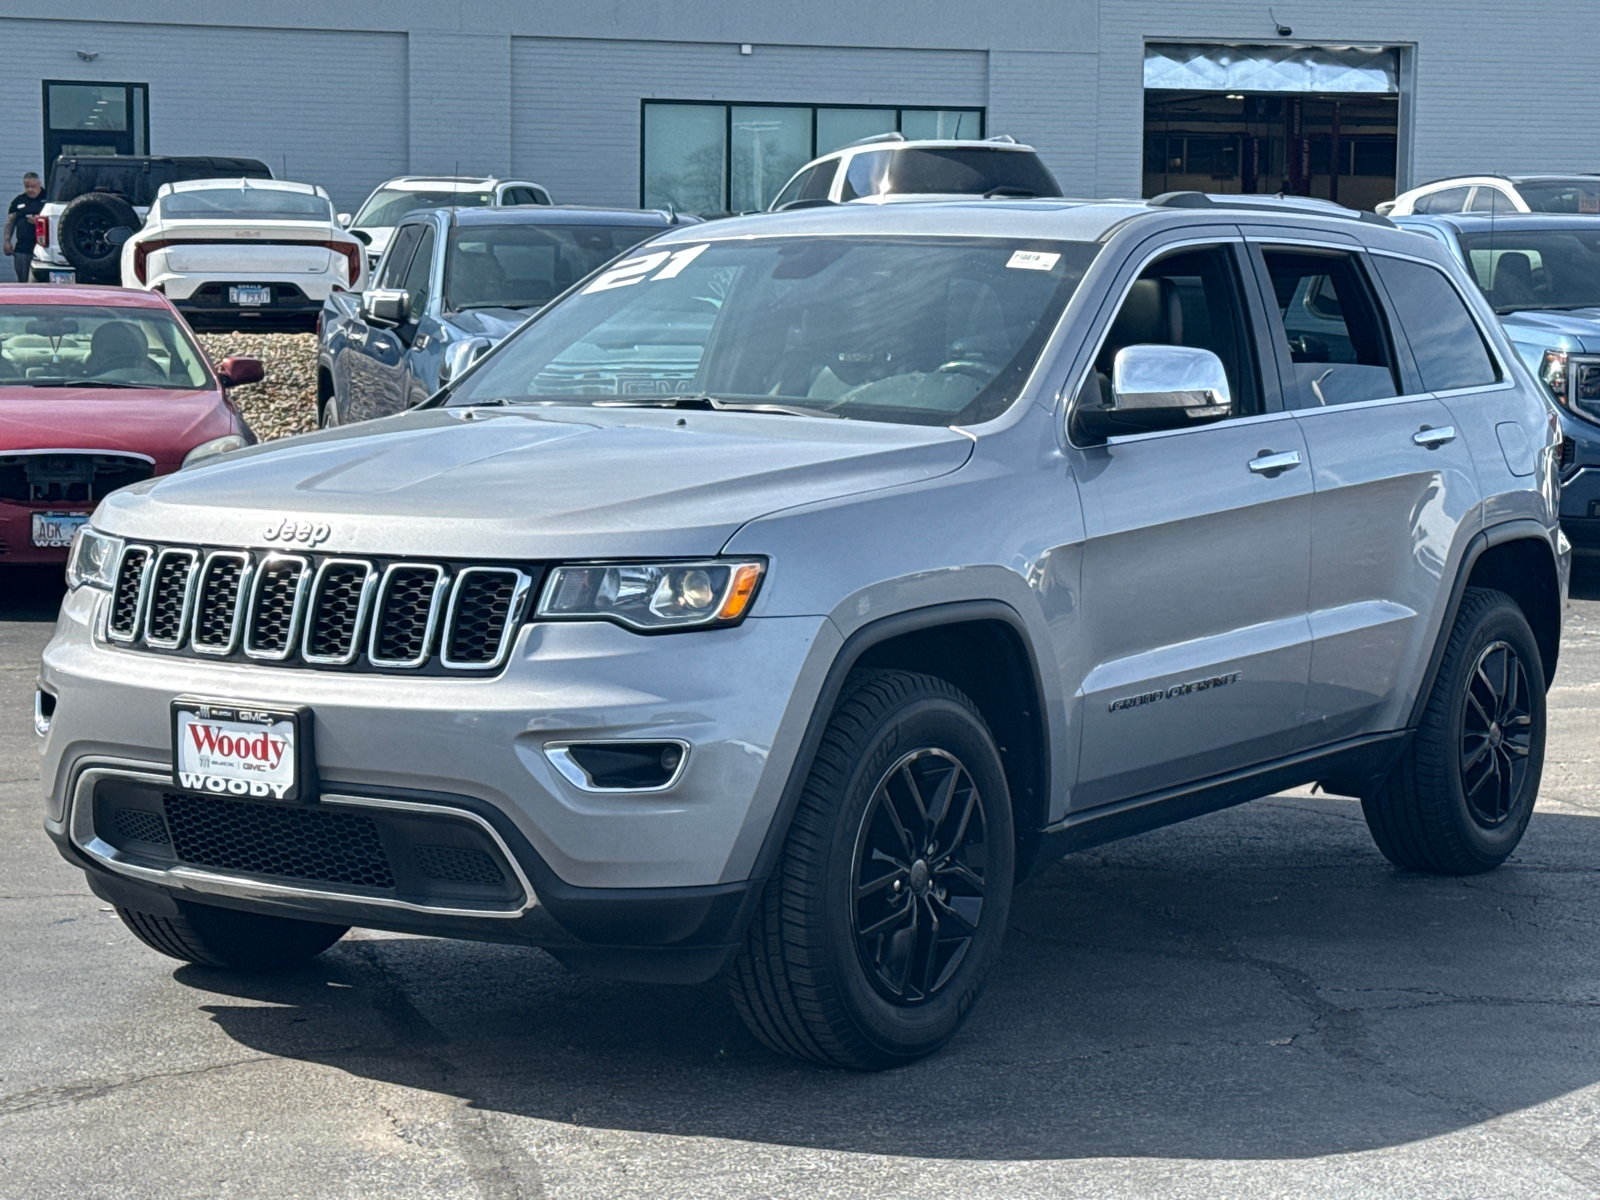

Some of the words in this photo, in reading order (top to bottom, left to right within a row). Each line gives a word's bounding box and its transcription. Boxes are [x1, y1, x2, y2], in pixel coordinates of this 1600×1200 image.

[580, 243, 711, 296] 21
[38, 522, 62, 539] AGK
[262, 516, 332, 549] Jeep
[1109, 690, 1163, 713] GRAND
[1166, 670, 1243, 698] CHEROKEE
[238, 711, 268, 722] GMC
[188, 723, 287, 771] Woody
[242, 762, 267, 773] GMC
[178, 772, 292, 799] WOODY
